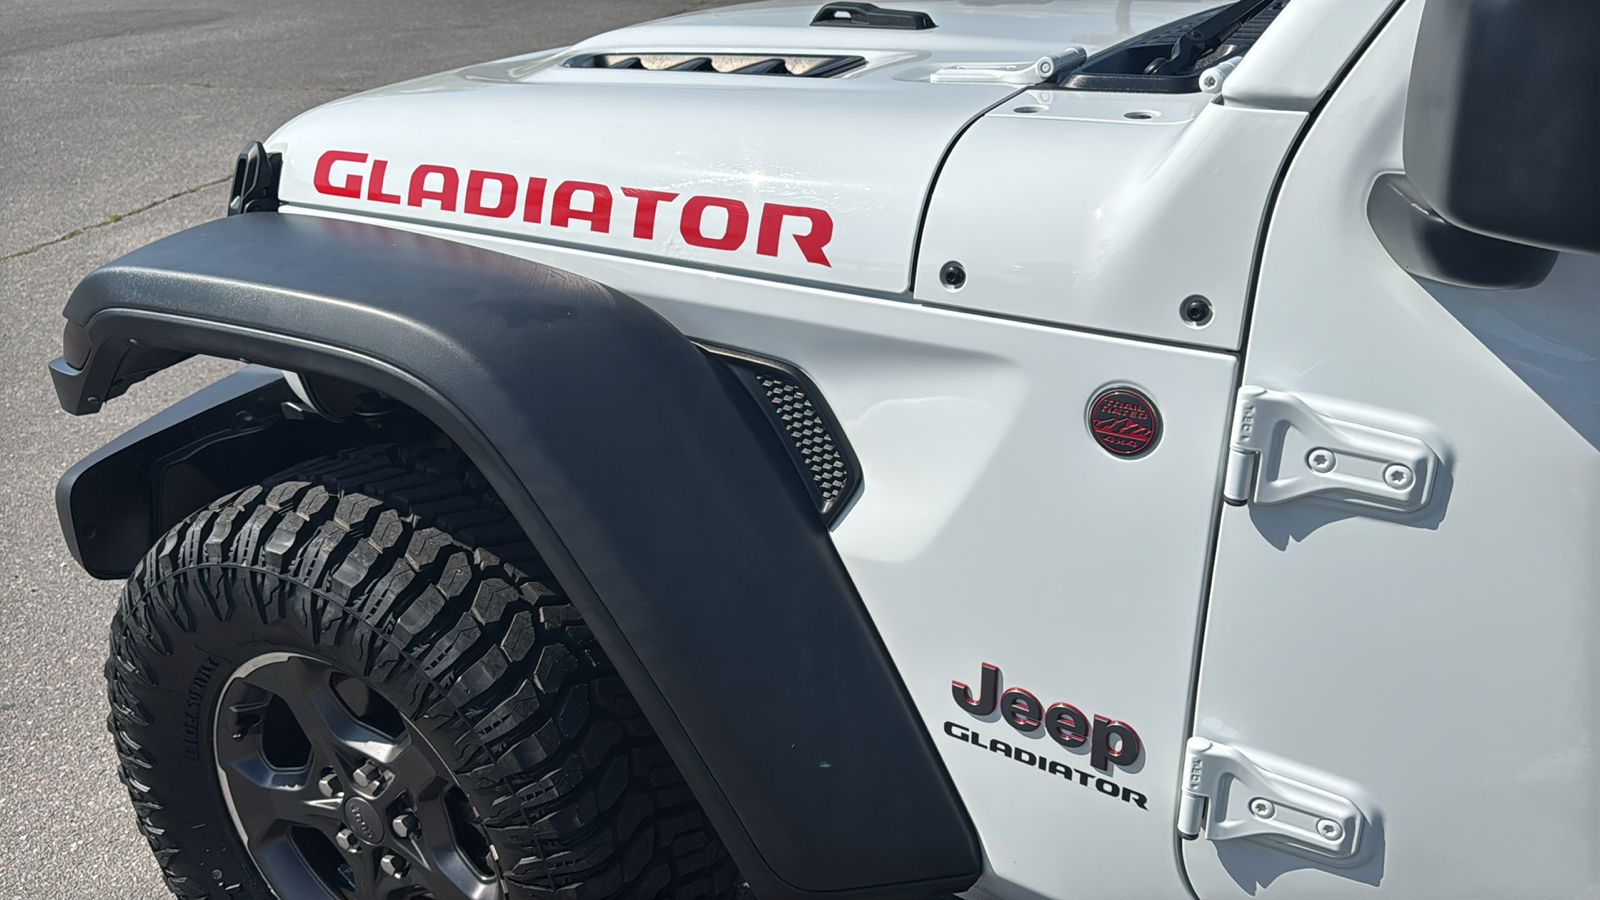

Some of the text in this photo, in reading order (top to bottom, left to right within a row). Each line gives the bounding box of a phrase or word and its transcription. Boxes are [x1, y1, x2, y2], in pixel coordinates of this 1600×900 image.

[313, 150, 834, 268] GLADIATOR
[1101, 405, 1148, 420] RATED
[1105, 399, 1146, 413] TRAIL
[951, 661, 1141, 772] Jeep
[943, 720, 1149, 812] GLADIATOR
